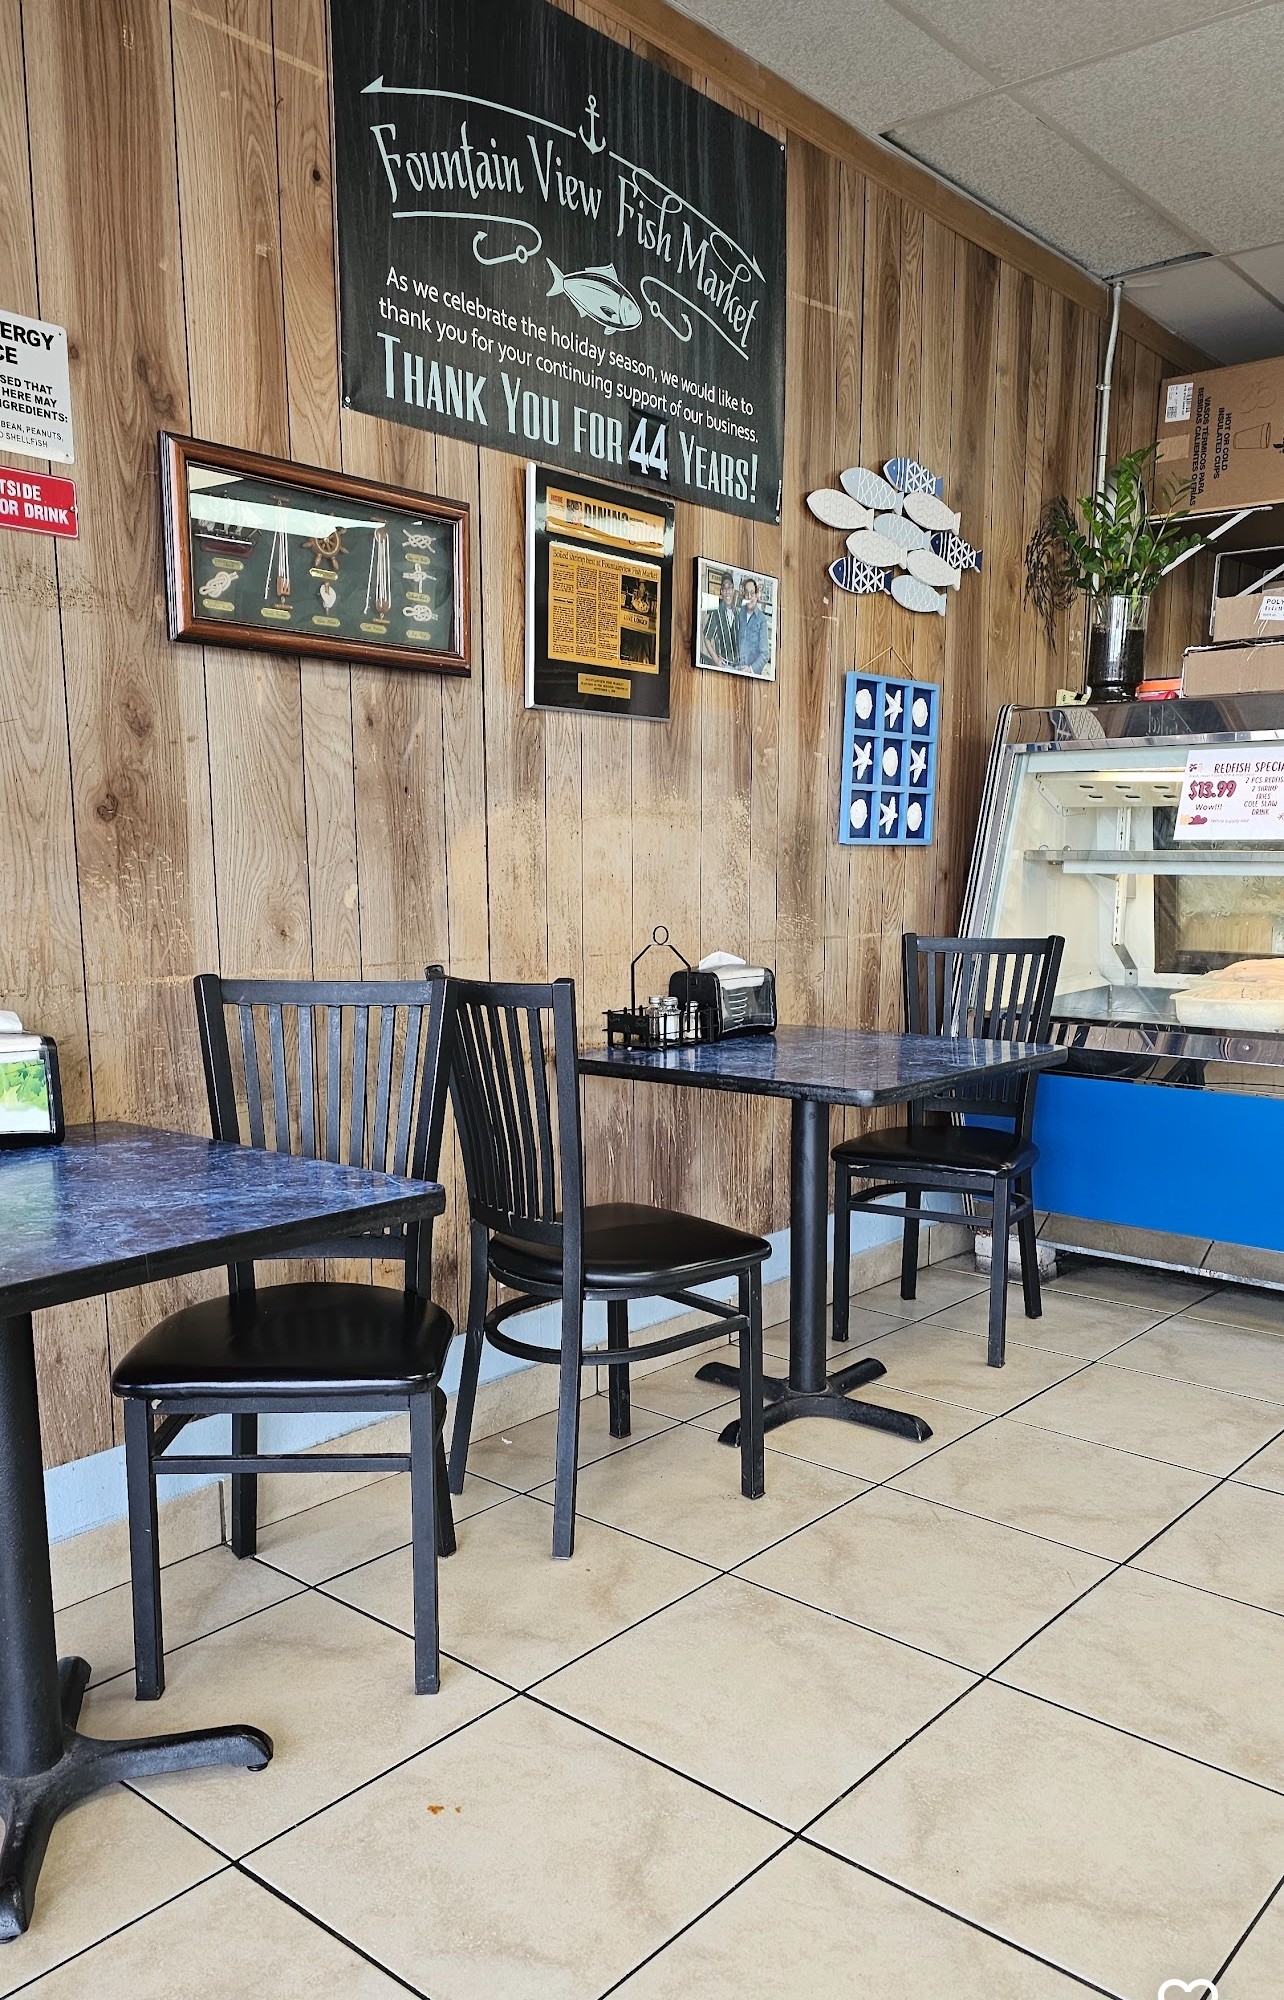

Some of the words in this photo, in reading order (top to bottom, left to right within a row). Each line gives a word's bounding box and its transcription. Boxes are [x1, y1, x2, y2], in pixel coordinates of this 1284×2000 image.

[370, 121, 524, 203] Fountain
[527, 135, 602, 220] View
[616, 174, 680, 262] Fish
[677, 222, 759, 347] Market
[0, 321, 54, 350] ERGY
[386, 266, 408, 292] As
[413, 279, 439, 302] we
[443, 292, 517, 332] celebrate
[521, 316, 547, 342] the
[551, 325, 605, 367] holiday
[609, 351, 658, 383] season,
[660, 370, 679, 388] we
[681, 377, 715, 403] would
[718, 388, 738, 411] like
[741, 397, 754, 416] to
[379, 297, 432, 333] thank
[436, 320, 467, 344] you
[471, 328, 494, 353] for
[498, 341, 532, 366] your
[536, 356, 613, 398] continuing
[616, 383, 667, 412] support
[670, 400, 682, 416] of
[683, 408, 703, 425] our
[706, 411, 759, 443] business.
[2, 387, 31, 402] HERE
[35, 395, 57, 408] MAY
[24, 380, 52, 395] THAT
[0, 399, 68, 423] GREDIENTS:
[377, 331, 489, 426] THANK
[500, 372, 560, 446] YOU
[573, 406, 623, 465] FOR
[628, 417, 669, 481] 44
[679, 430, 758, 503] YEARS!
[1195, 387, 1204, 424] BEBIDAS
[1202, 396, 1211, 425] VASOS
[1, 420, 24, 433] BEAN,
[26, 426, 64, 442] PEANUTS,
[1215, 407, 1225, 454] INSULATED
[1224, 413, 1232, 431] HOT
[6, 432, 48, 448] SHELLFISH
[1192, 426, 1202, 472] CALIENTES
[1223, 433, 1230, 446] OR
[1213, 456, 1221, 480] CUPS
[1221, 447, 1229, 471] COLD
[1197, 472, 1205, 494] PARA
[0, 498, 19, 516] OR
[24, 502, 69, 525] DRINK
[1214, 763, 1251, 773] REDFISH
[1188, 780, 1237, 800] $13.99
